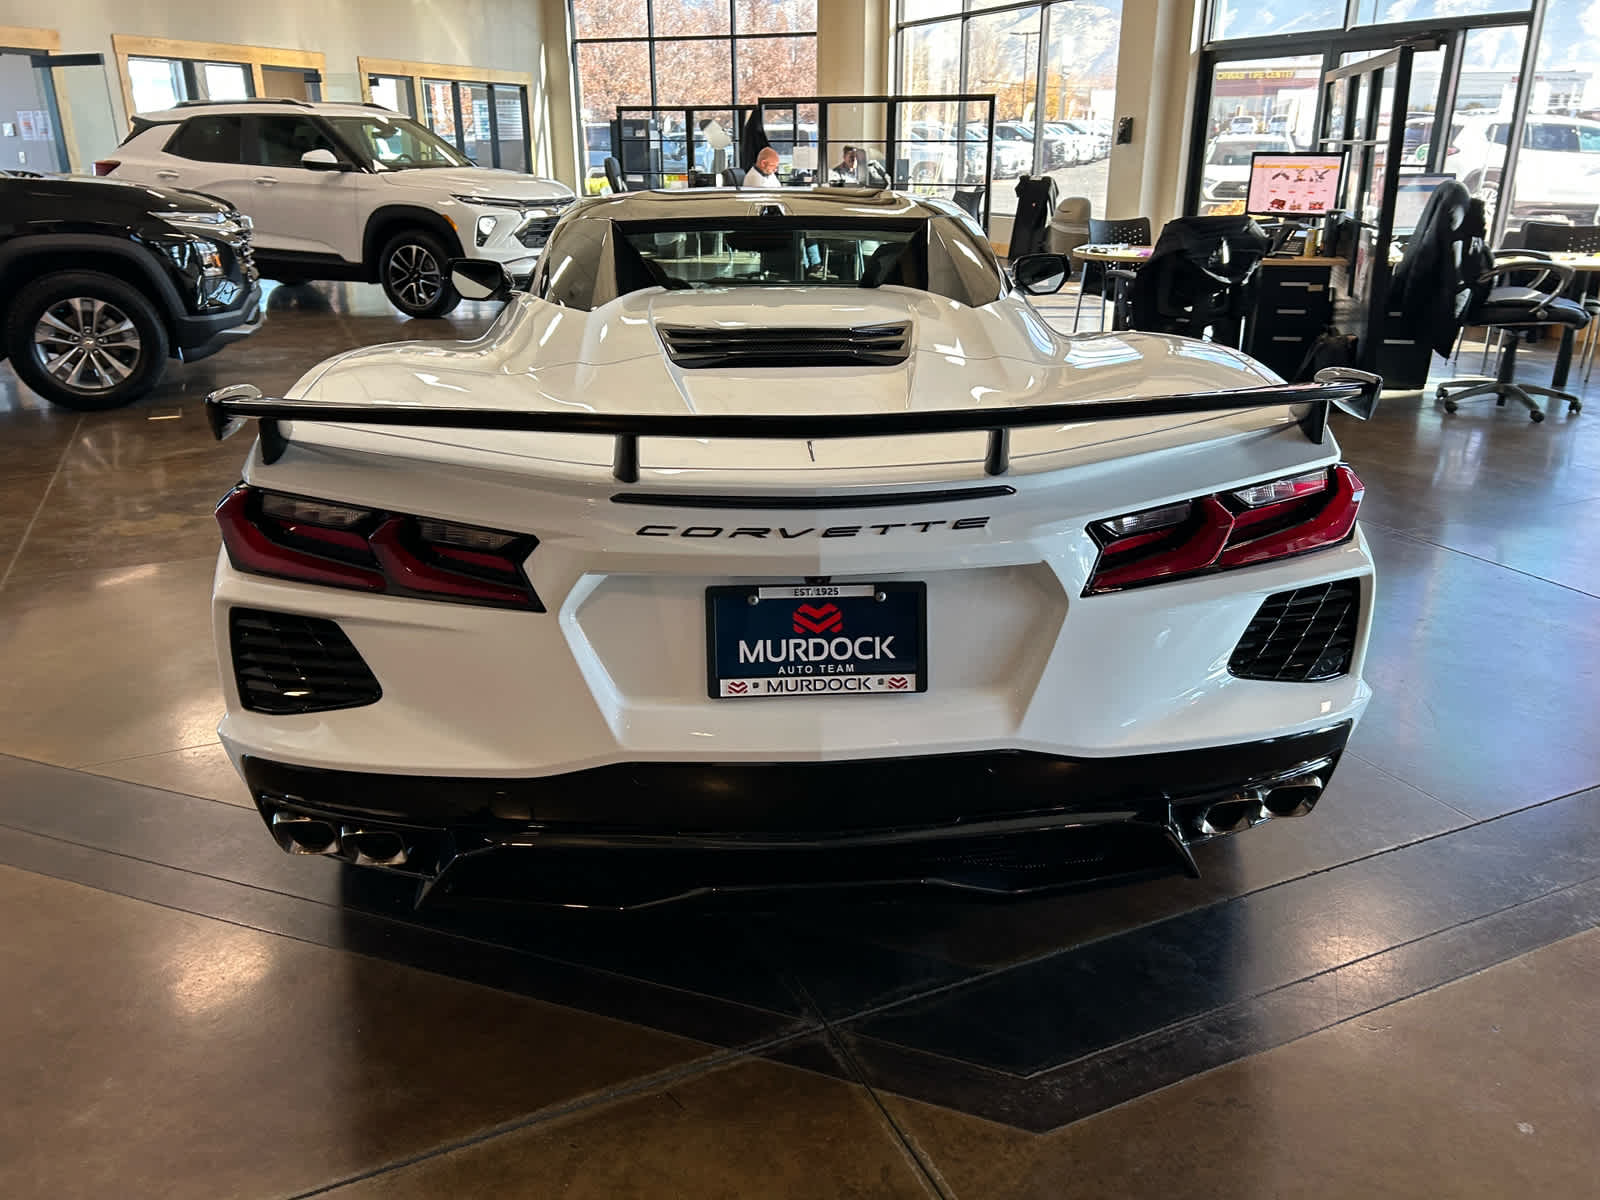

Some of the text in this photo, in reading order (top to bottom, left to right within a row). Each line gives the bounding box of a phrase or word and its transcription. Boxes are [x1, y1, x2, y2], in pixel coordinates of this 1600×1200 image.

[636, 515, 991, 539] CORVETTE
[793, 586, 839, 597] EST. 1925
[738, 635, 896, 664] MURDOCK
[778, 663, 855, 675] AUTO TEAM
[766, 677, 872, 693] MURDOCK
